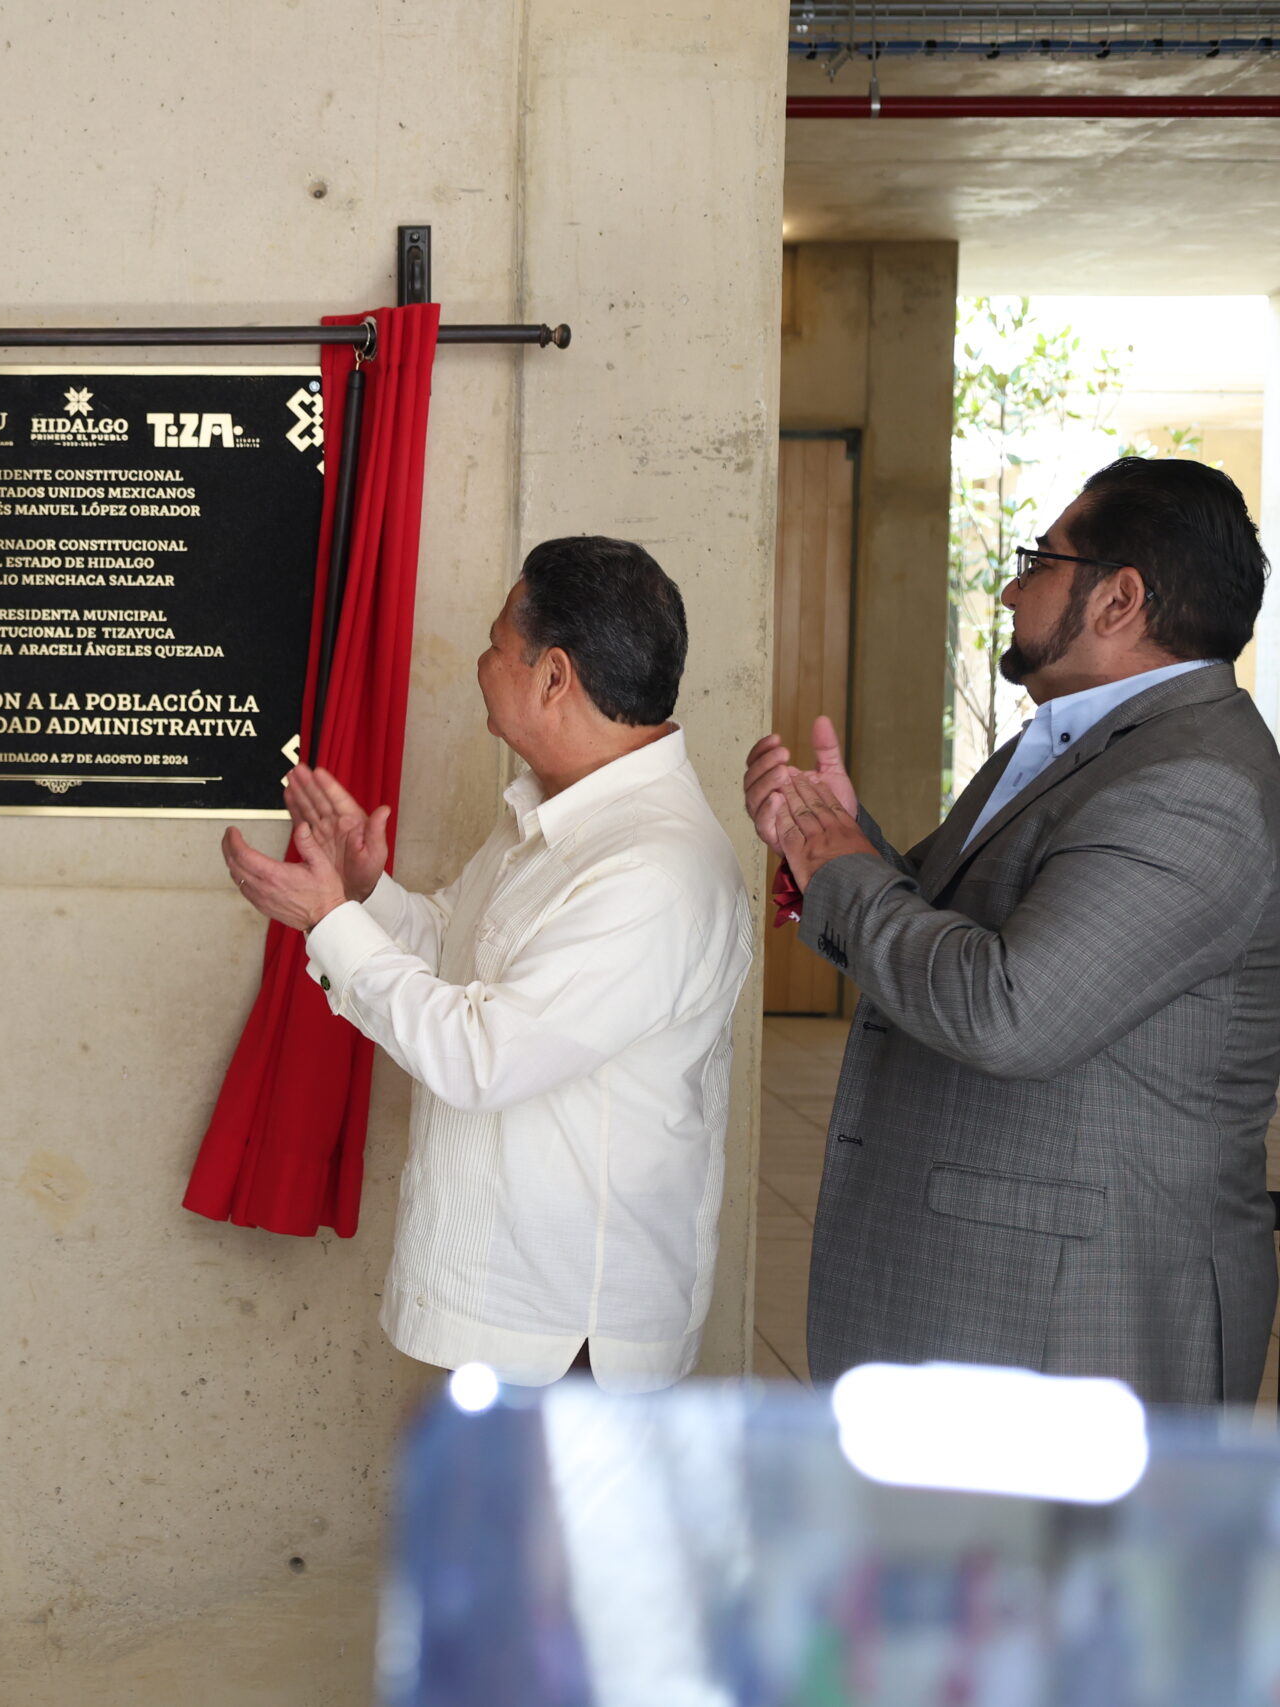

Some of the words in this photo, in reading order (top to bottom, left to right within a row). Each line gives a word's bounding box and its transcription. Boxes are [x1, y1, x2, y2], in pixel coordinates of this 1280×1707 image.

[30, 417, 129, 434] HIDALGO
[30, 433, 74, 441] PRIMERO
[76, 433, 89, 442] EL
[90, 432, 129, 442] PUEBLO
[54, 468, 185, 482] CONSTITUCIONAL
[47, 486, 106, 499] UNIDOS
[107, 486, 196, 500] MEXICANOS
[14, 503, 79, 516] MANUEL
[80, 500, 128, 517] LÓPEZ
[129, 504, 201, 517] OBRADOR
[58, 538, 188, 552] CONSTITUCIONAL
[5, 556, 63, 569] ESTADO
[64, 556, 85, 569] DE
[87, 556, 155, 570] HIDALGO
[21, 573, 107, 587] MENCHACA
[108, 574, 176, 587] SALAZAR
[82, 609, 168, 622] MUNICIPAL
[76, 626, 97, 639] DE
[101, 626, 176, 640] TIZAYUCA
[18, 643, 83, 657] ARACELI
[83, 640, 153, 657] ÁNGELES
[154, 644, 225, 659] QUEZADA
[26, 692, 45, 711] A
[48, 692, 81, 711] LA
[84, 688, 223, 713] POBLACIÓN
[228, 694, 261, 713] LA
[45, 716, 258, 737] ADMINISTRATIVA
[49, 752, 60, 764] A
[60, 752, 75, 764] 27
[76, 753, 94, 764] DE
[94, 753, 143, 765] AGOSTO
[143, 754, 161, 765] DE
[161, 754, 189, 765] 2024
